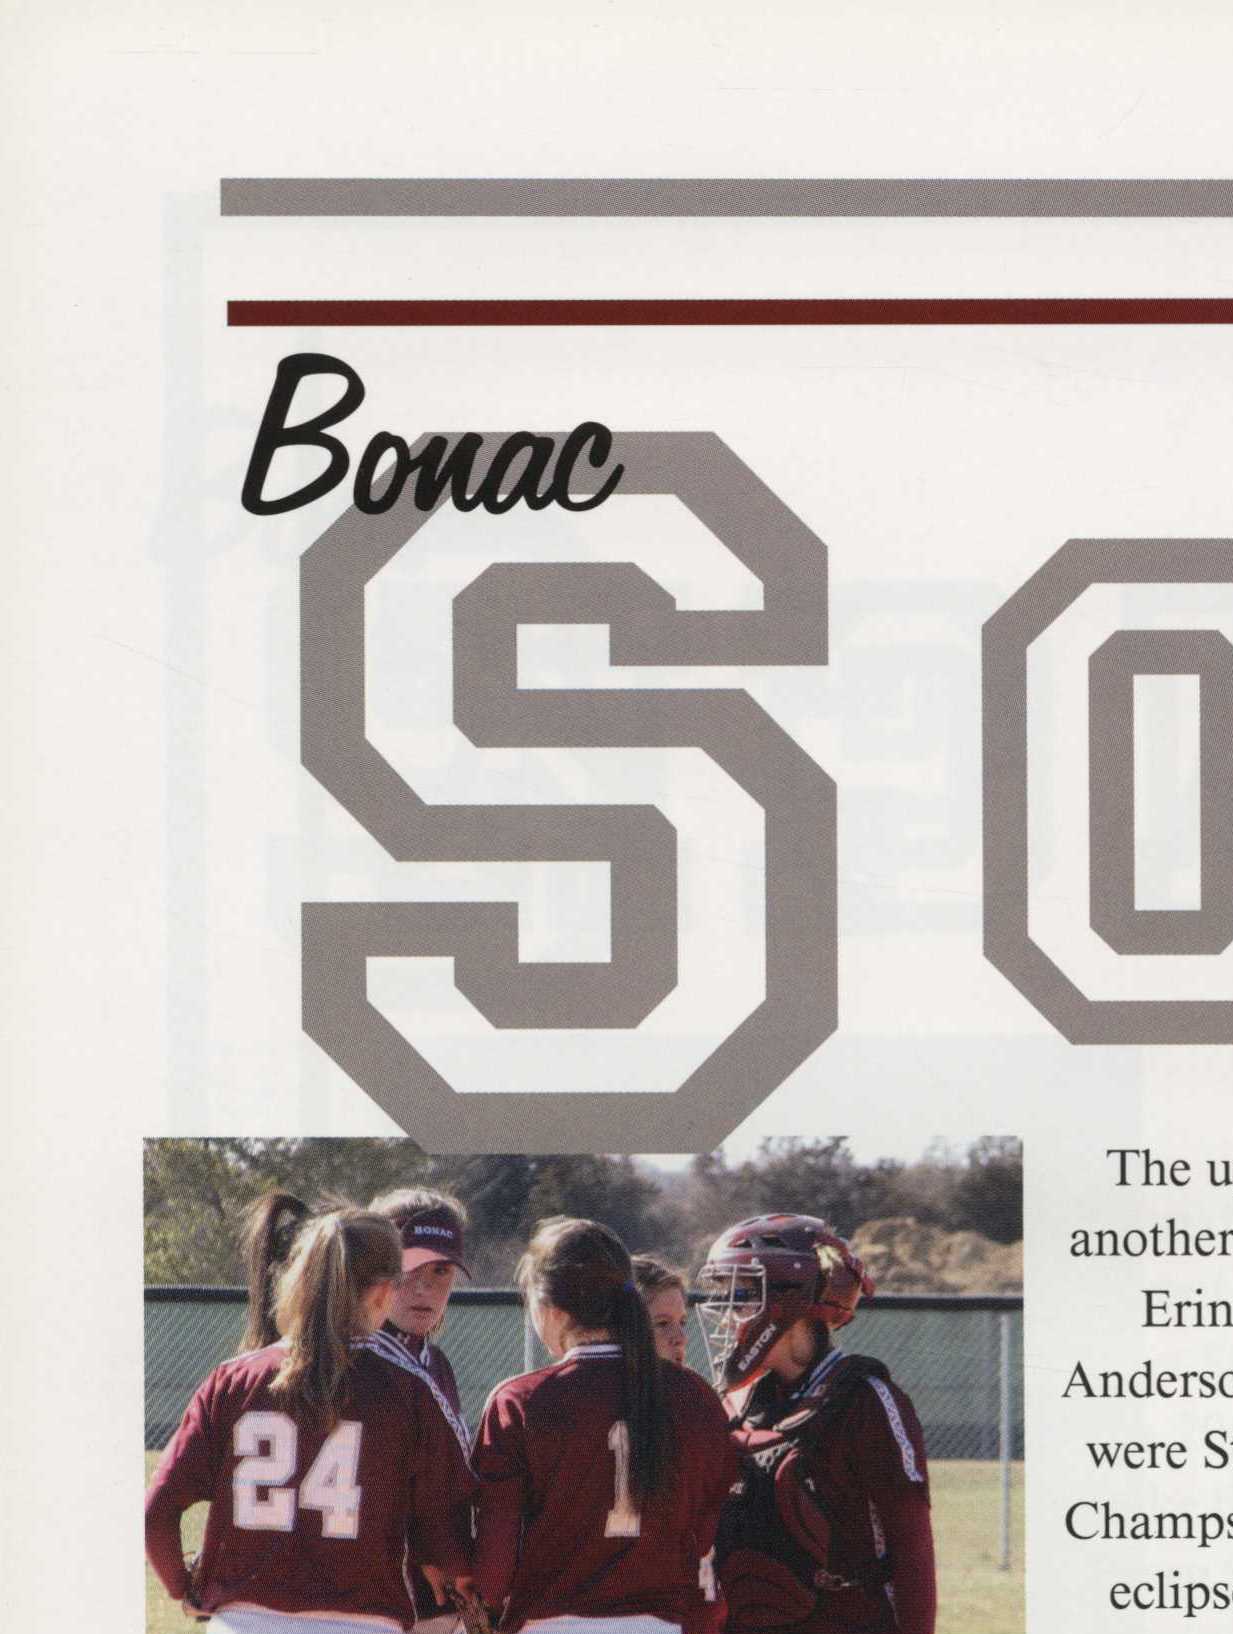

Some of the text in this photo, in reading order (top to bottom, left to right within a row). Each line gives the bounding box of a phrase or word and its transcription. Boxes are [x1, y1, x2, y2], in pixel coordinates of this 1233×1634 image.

[240, 352, 625, 516] Bonac
[1106, 1148, 1191, 1187] The
[232, 1410, 364, 1540] 24
[1086, 1441, 1187, 1470] were
